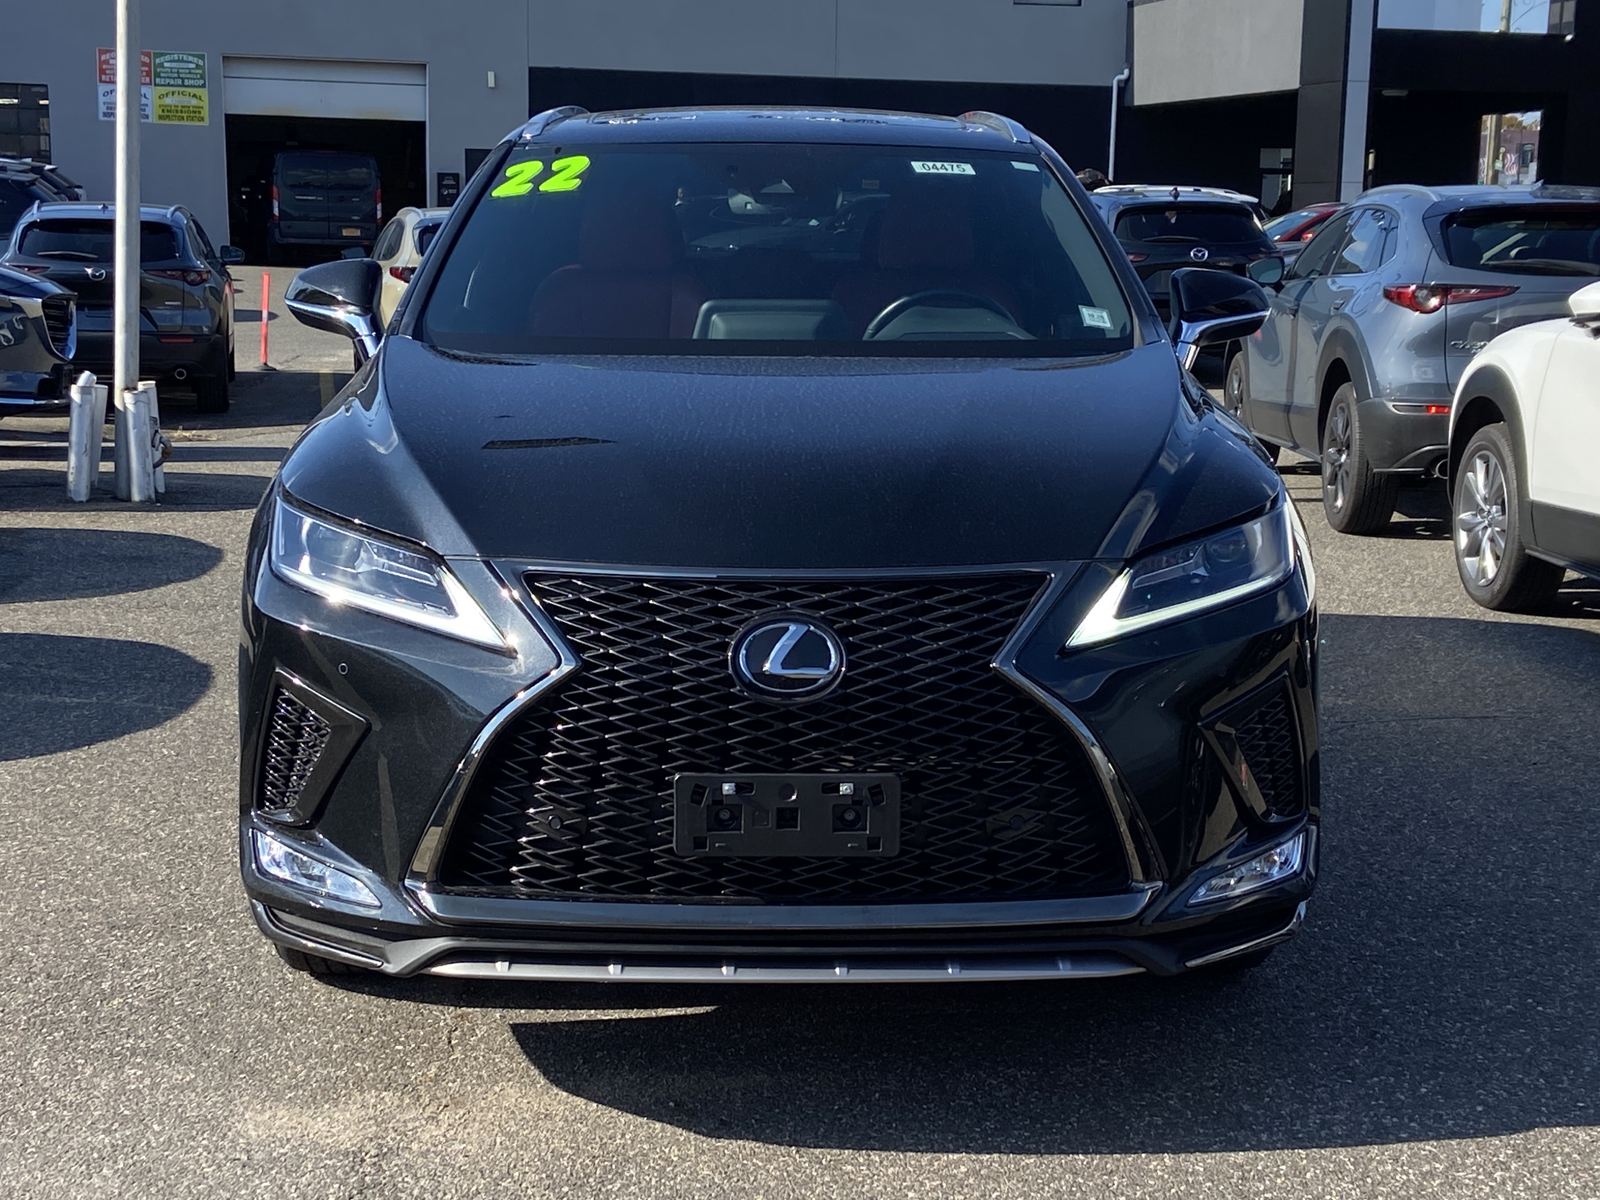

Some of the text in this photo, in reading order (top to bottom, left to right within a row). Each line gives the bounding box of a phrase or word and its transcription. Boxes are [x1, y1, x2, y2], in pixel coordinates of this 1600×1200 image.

[155, 54, 204, 66] REGISTERED
[158, 90, 204, 102] OFFICIAL
[921, 162, 967, 173] 04475
[491, 155, 591, 198] 22
